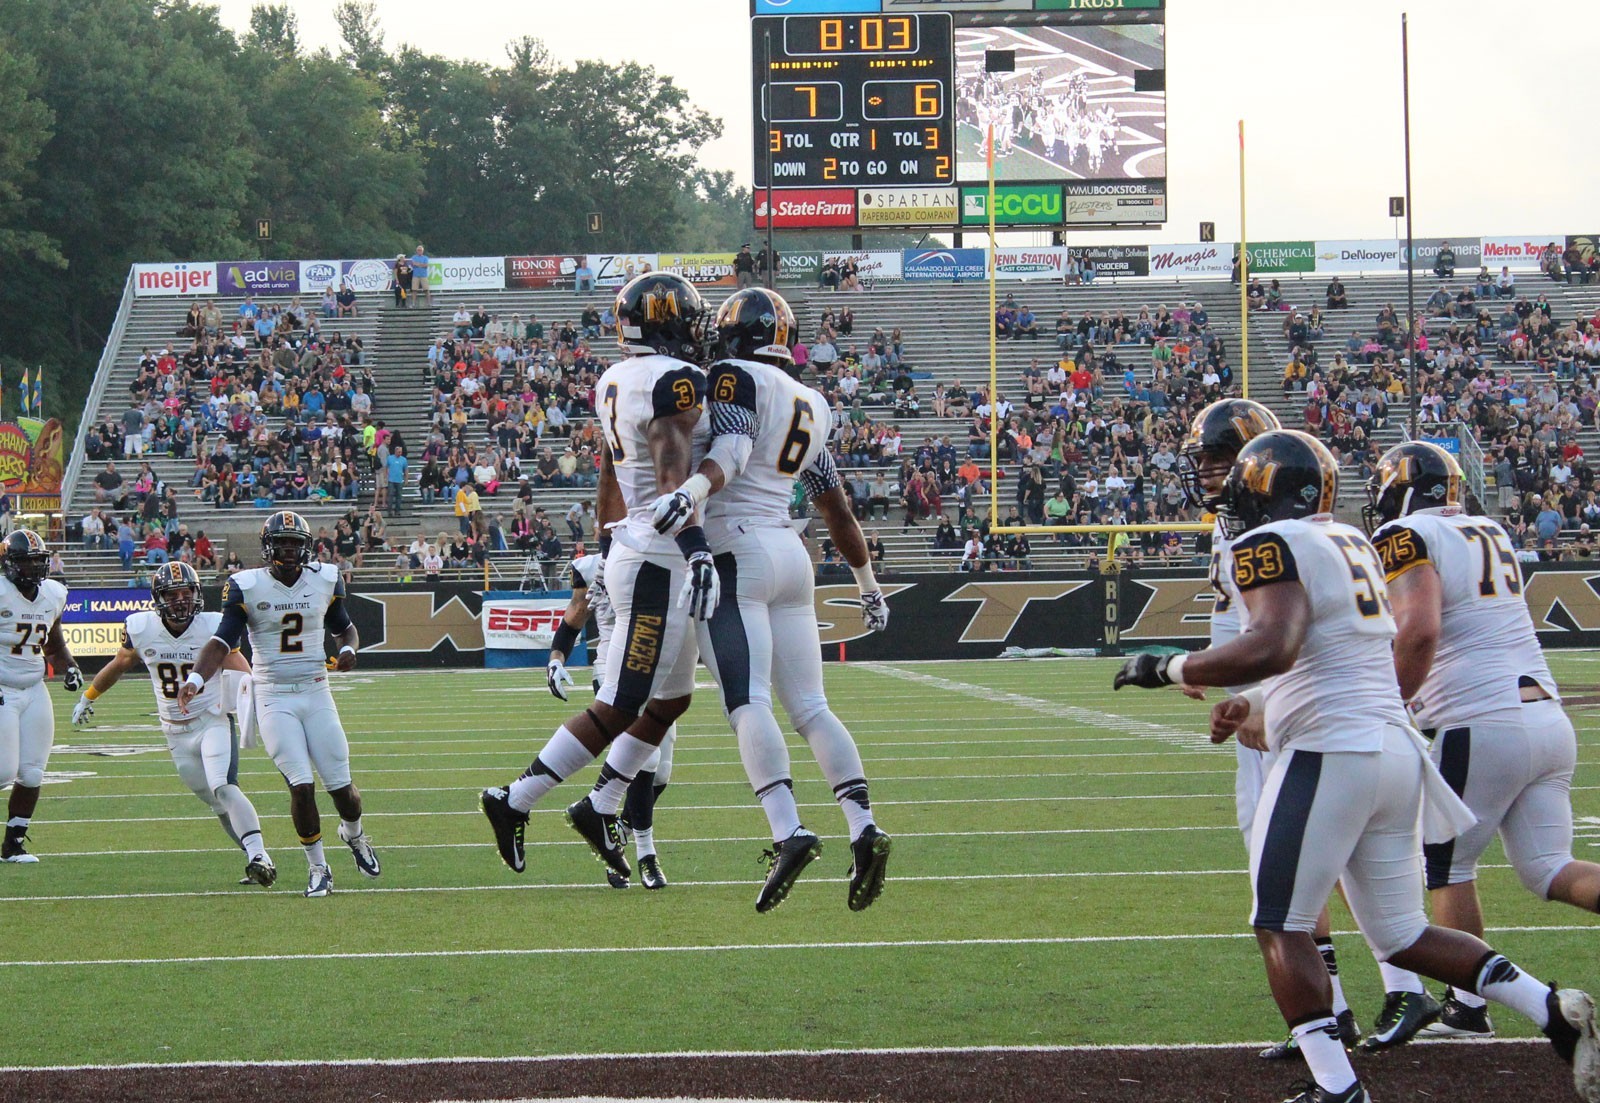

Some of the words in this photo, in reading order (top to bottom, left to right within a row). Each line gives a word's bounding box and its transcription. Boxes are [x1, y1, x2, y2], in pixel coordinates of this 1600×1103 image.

[820, 18, 910, 50] 8:03
[795, 86, 816, 117] 7
[915, 85, 938, 115] 6
[784, 133, 813, 148] TOL
[830, 132, 860, 149] QTR
[893, 132, 922, 146] TOL
[925, 128, 938, 149] 3
[774, 162, 806, 176] DOWN
[823, 158, 836, 179] 2
[840, 161, 860, 175] TO
[866, 161, 887, 175] GO
[900, 160, 918, 174] ON
[936, 156, 949, 177] 2
[877, 193, 955, 208] SPARTAN
[986, 193, 1060, 216] ECCU
[1393, 199, 1400, 215] L
[591, 215, 598, 230] J
[862, 209, 911, 221] PAPERBOARD
[915, 209, 954, 220] COMPANY
[259, 222, 268, 237] H
[1202, 222, 1211, 240] K
[1152, 248, 1217, 270] Mangia
[1254, 248, 1315, 259] CHEMICAL
[1341, 250, 1398, 263] DeNooyer
[1484, 243, 1521, 256] Metro
[444, 262, 504, 281] copydesk
[512, 260, 555, 270] HONOR
[1021, 252, 1062, 272] STATION
[1097, 262, 1129, 270] KYOCERA
[139, 265, 211, 293] meijer
[244, 267, 295, 282] advia
[672, 378, 696, 411] 3
[715, 373, 737, 403] 6
[776, 396, 814, 475] 6
[24, 498, 50, 511] CORN
[1234, 542, 1283, 586] 53
[1457, 524, 1521, 597] 75
[274, 603, 294, 611] MURRAY
[1104, 581, 1118, 645] ROW
[11, 622, 49, 655] 73
[61, 627, 122, 644] consu
[280, 612, 303, 653] 2
[626, 614, 662, 674] RACERS
